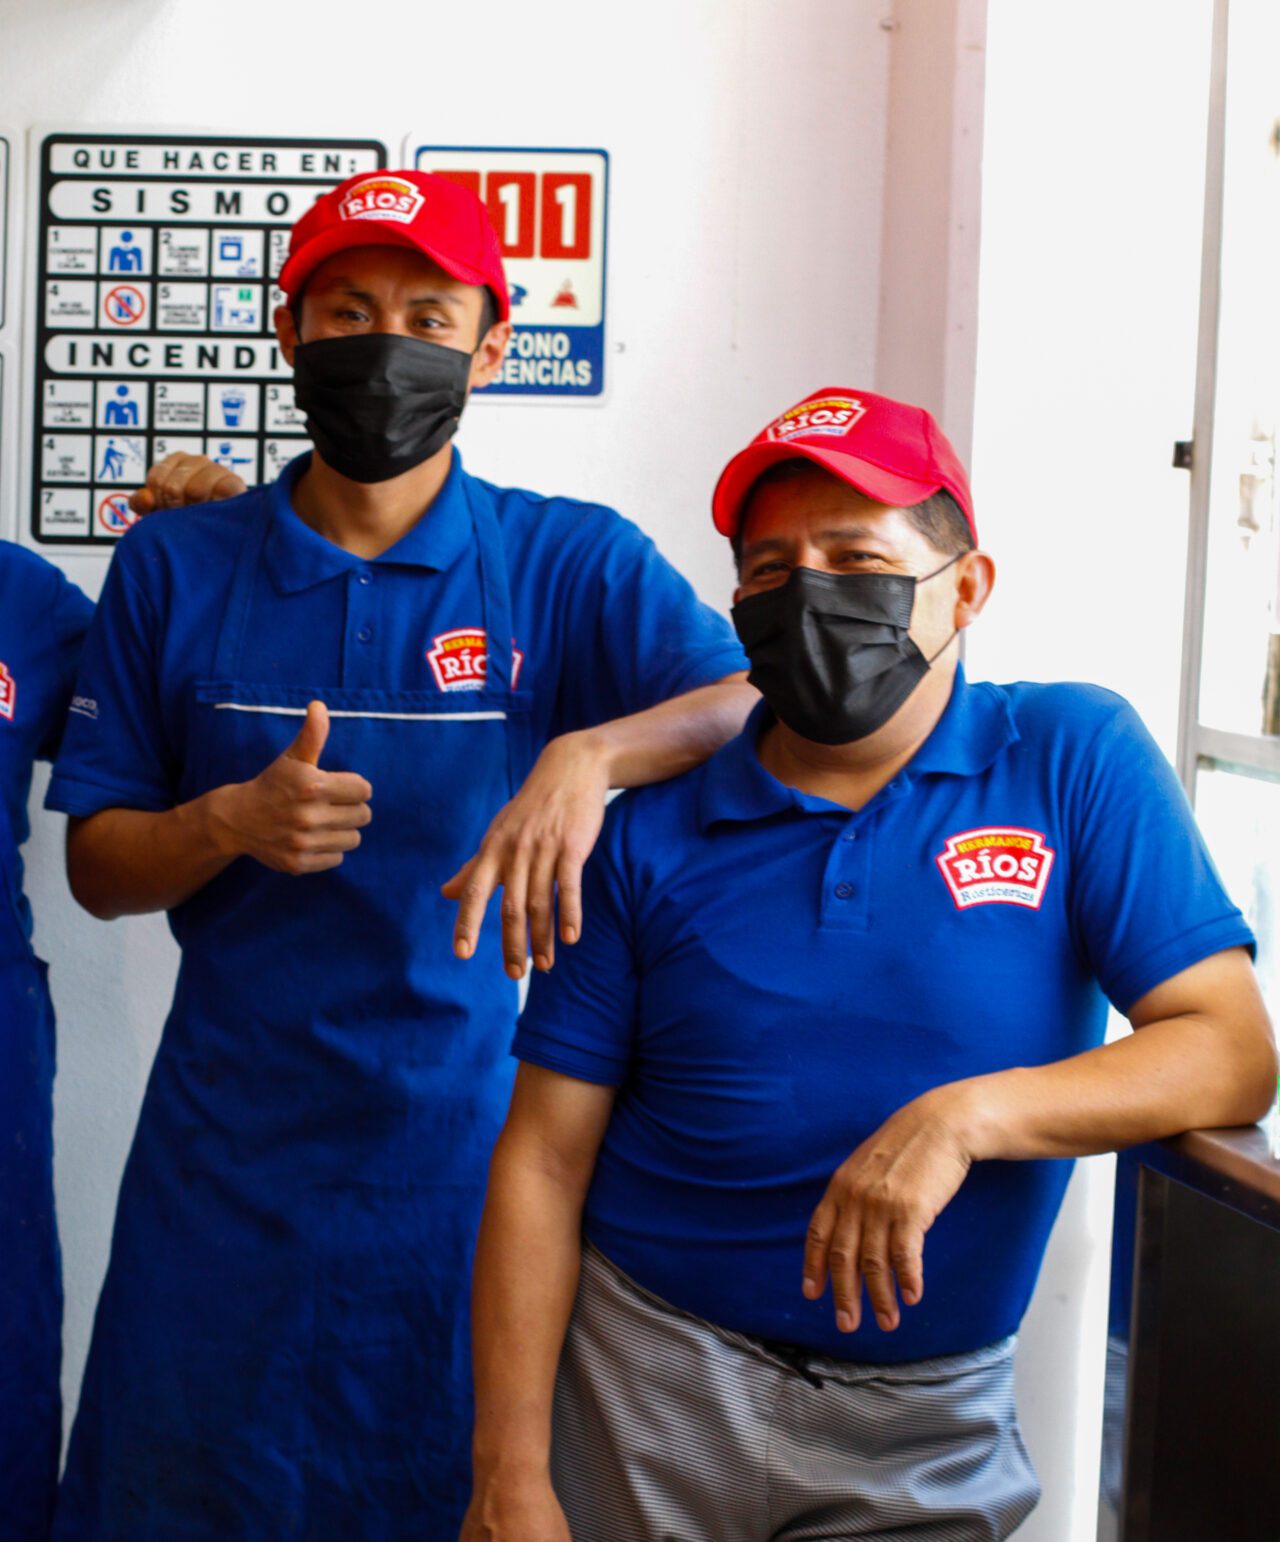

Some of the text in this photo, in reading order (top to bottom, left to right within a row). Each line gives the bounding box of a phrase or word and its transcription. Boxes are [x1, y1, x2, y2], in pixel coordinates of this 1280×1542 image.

[73, 149, 357, 174] QUE HACER EN:
[91, 188, 327, 216] SISMO
[346, 190, 415, 215] RÍOS
[497, 182, 577, 248] 11
[51, 229, 59, 242] 1
[161, 231, 172, 244] 2
[273, 233, 284, 246] 3
[48, 283, 58, 296] 4
[161, 286, 171, 299] 5
[270, 288, 282, 301] 6
[49, 384, 56, 396] 1
[158, 385, 168, 398] 2
[268, 388, 279, 400] 3
[778, 409, 853, 434] RÍOS
[44, 438, 55, 451] 4
[156, 440, 167, 453] 5
[267, 443, 278, 456] 6
[45, 491, 55, 504] 7
[956, 836, 1034, 854] HERMANOS
[953, 848, 1040, 883] RÍOS
